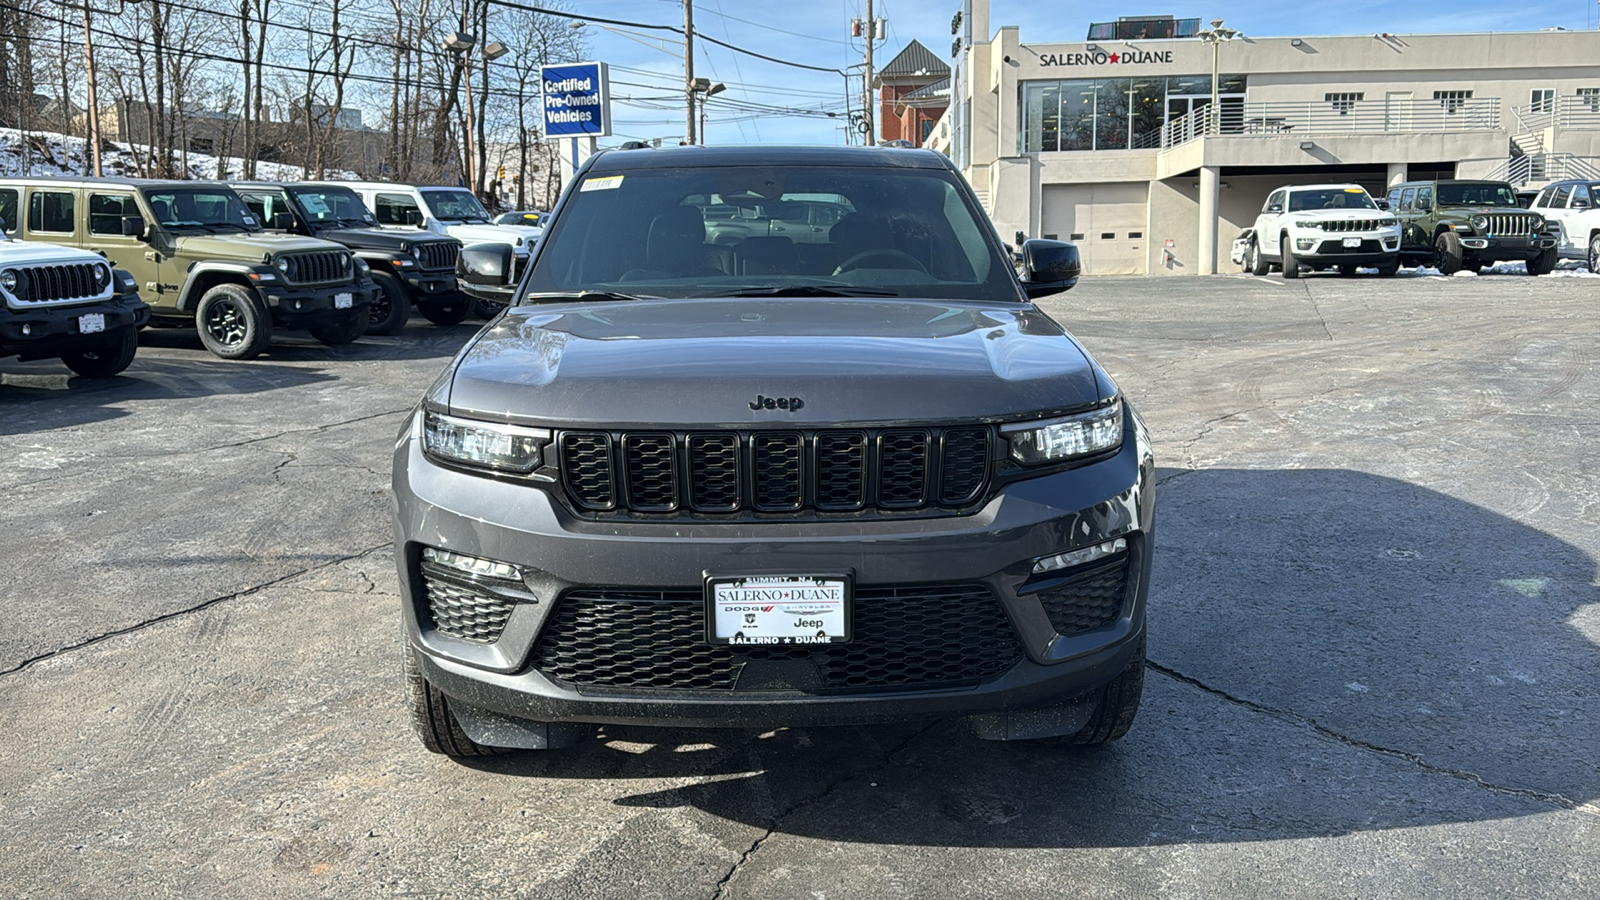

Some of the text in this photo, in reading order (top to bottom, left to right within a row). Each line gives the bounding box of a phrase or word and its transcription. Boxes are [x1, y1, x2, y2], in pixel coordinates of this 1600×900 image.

[1039, 51, 1173, 67] SALERNO DUANE
[545, 77, 590, 92] Certified
[546, 93, 598, 108] Pre-Owned
[547, 109, 592, 123] Vehicles
[748, 394, 805, 412] Jeep
[718, 589, 840, 601] SALERNO DUANE
[794, 618, 824, 629] Jeep
[728, 635, 832, 645] SALERNO DUANE
